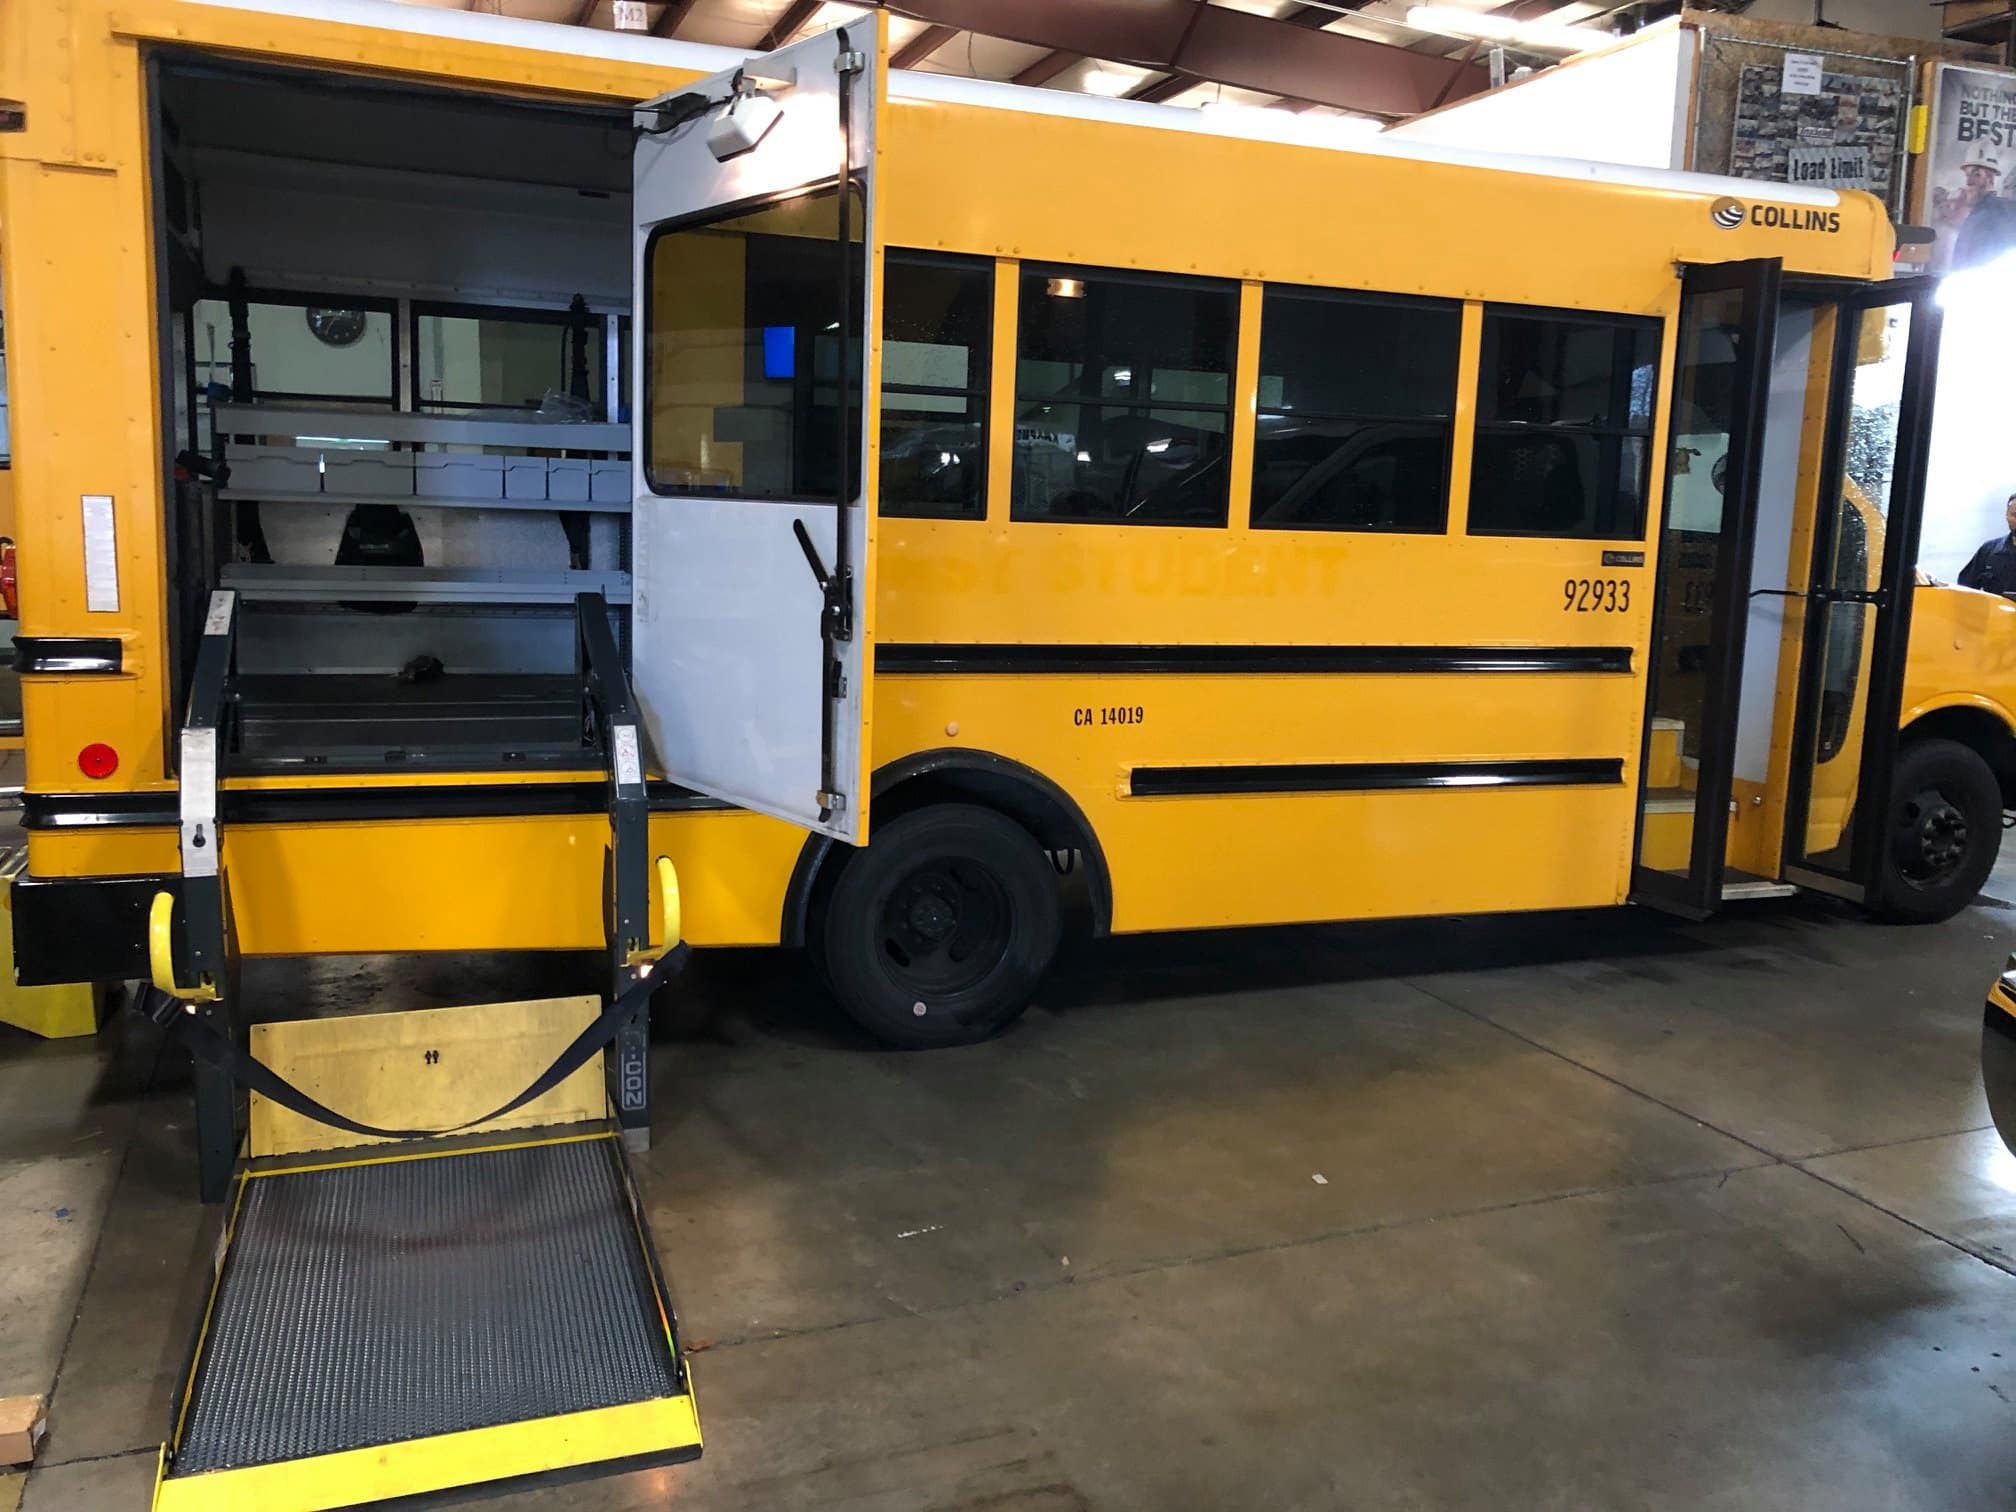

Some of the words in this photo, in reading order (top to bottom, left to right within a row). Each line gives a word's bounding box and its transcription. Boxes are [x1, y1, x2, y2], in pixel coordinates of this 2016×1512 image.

[1960, 100, 1989, 118] BUT
[1992, 105, 2016, 122] THE
[1958, 117, 2016, 147] BEST
[1793, 157, 1826, 181] Load
[1830, 156, 1864, 179] Limit
[1751, 204, 1840, 233] COLLINS
[1563, 579, 1630, 613] 92933
[1074, 708, 1093, 727] CA
[1101, 706, 1144, 725] 14019
